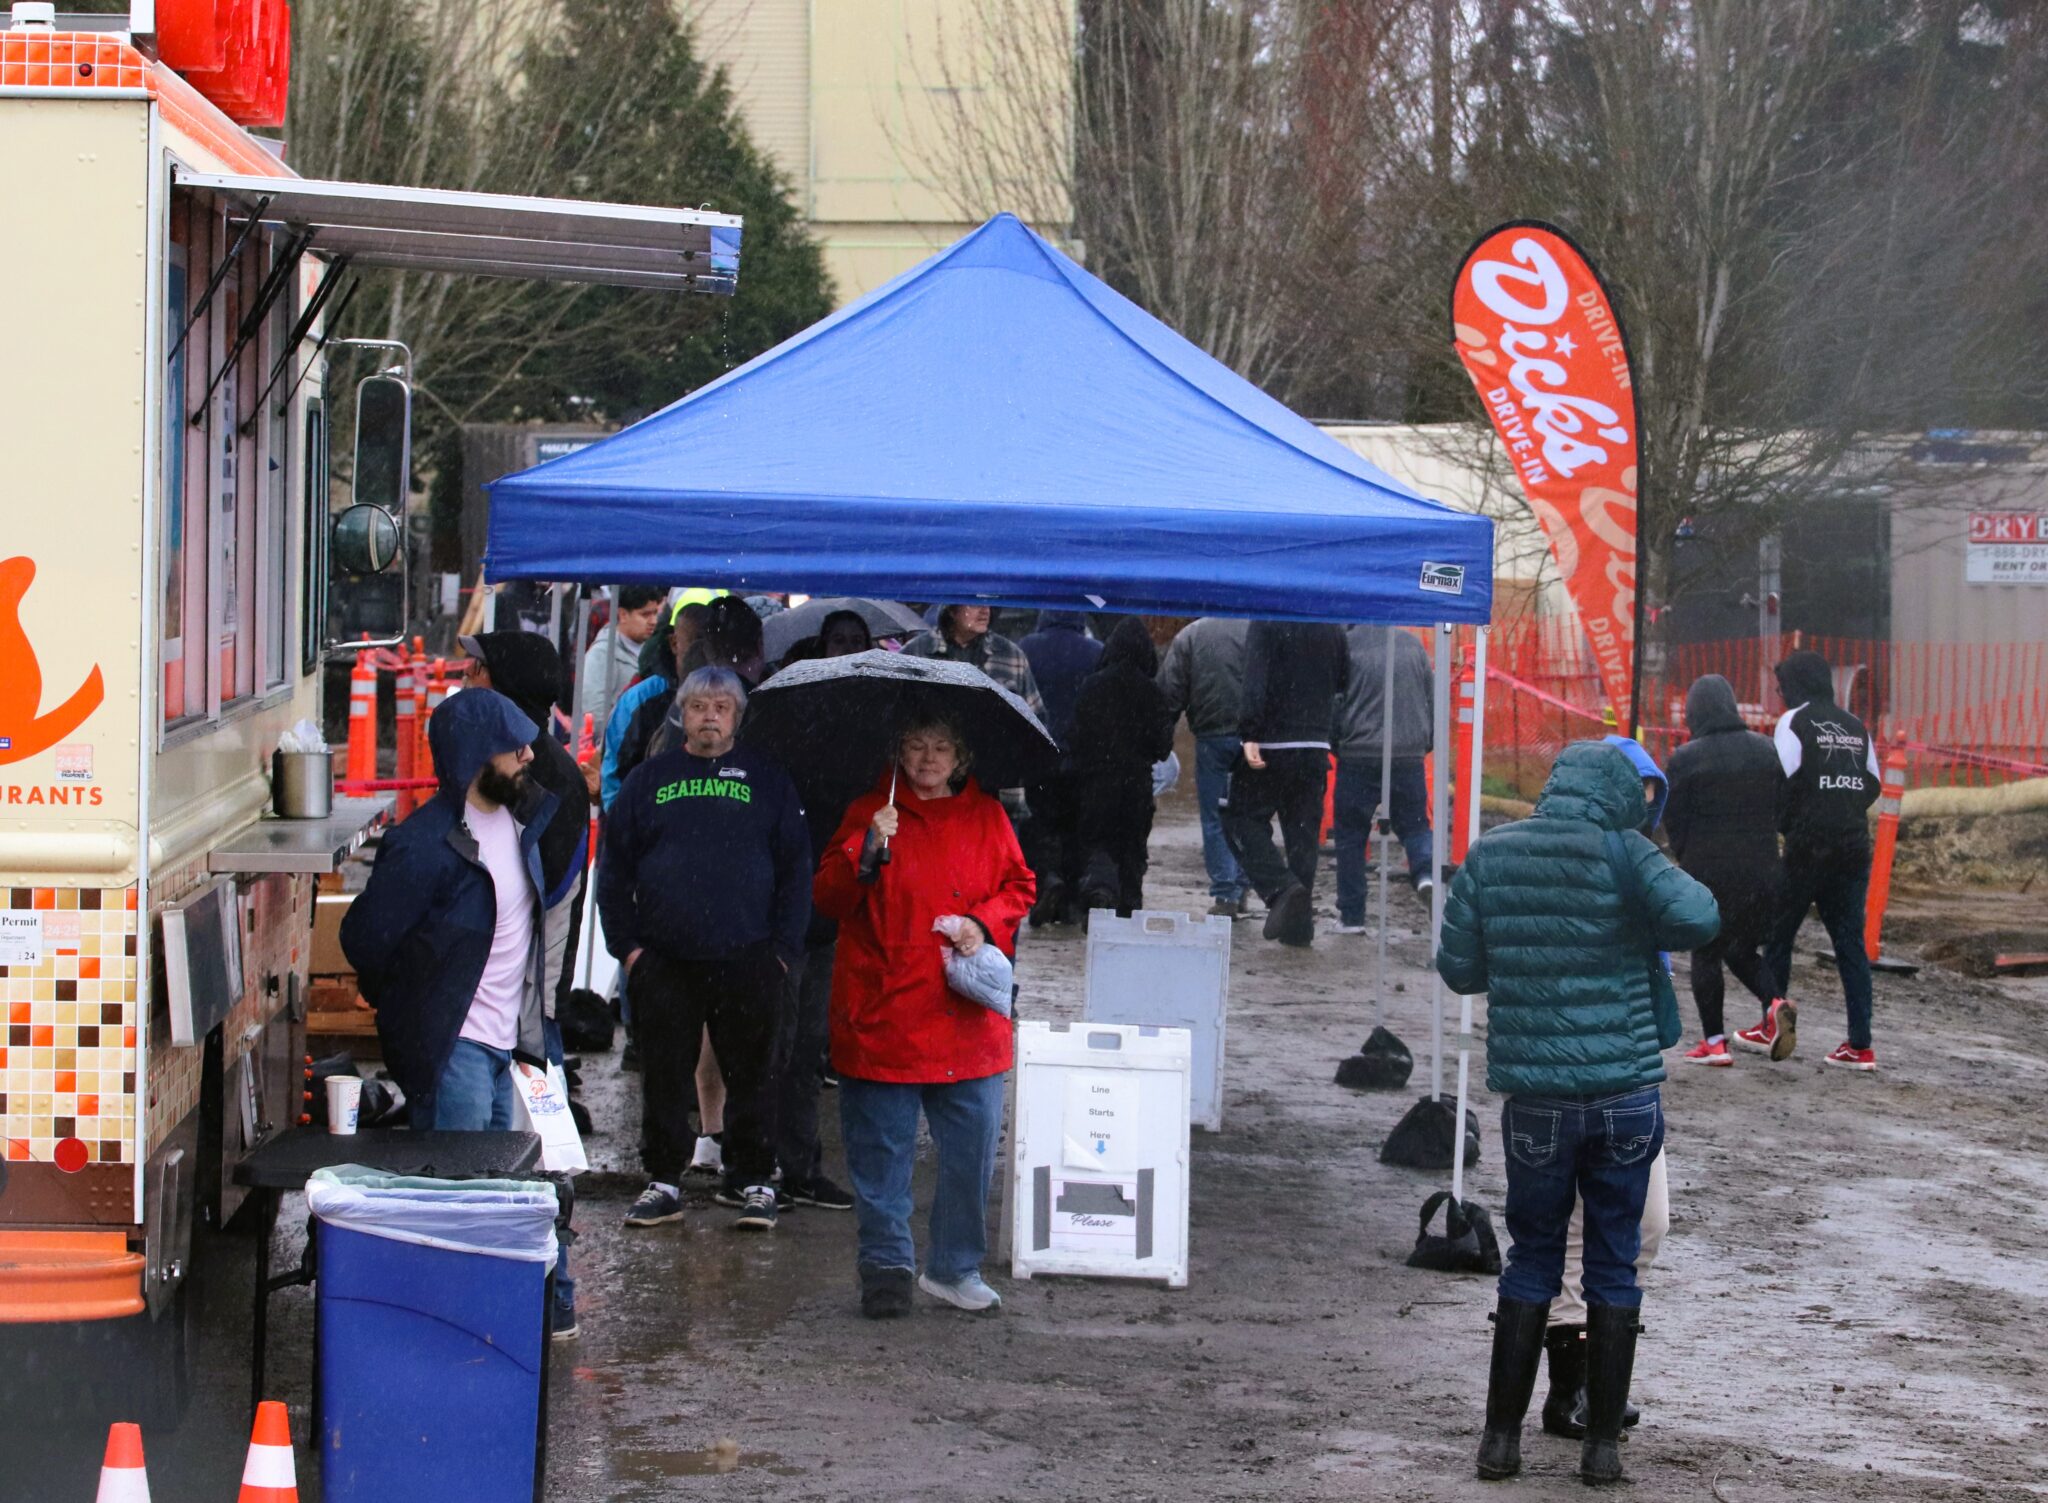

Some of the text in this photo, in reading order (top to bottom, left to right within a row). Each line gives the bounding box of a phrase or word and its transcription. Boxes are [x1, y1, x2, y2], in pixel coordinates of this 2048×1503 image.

[1577, 290, 1631, 389] DRIVE-IN
[1471, 238, 1629, 478] Dick's
[1488, 387, 1549, 485] DRIVE-IN
[1422, 572, 1459, 587] Eurmax
[1819, 774, 1864, 791] FLORES
[0, 785, 103, 806] RANTS
[655, 778, 751, 805] SEAHAWKS
[2, 917, 38, 927] Permit
[24, 951, 36, 961] 24
[1091, 1085, 1110, 1094] Line
[1088, 1108, 1115, 1117] Starts
[1089, 1131, 1111, 1140] Here
[1070, 1213, 1114, 1227] Please
